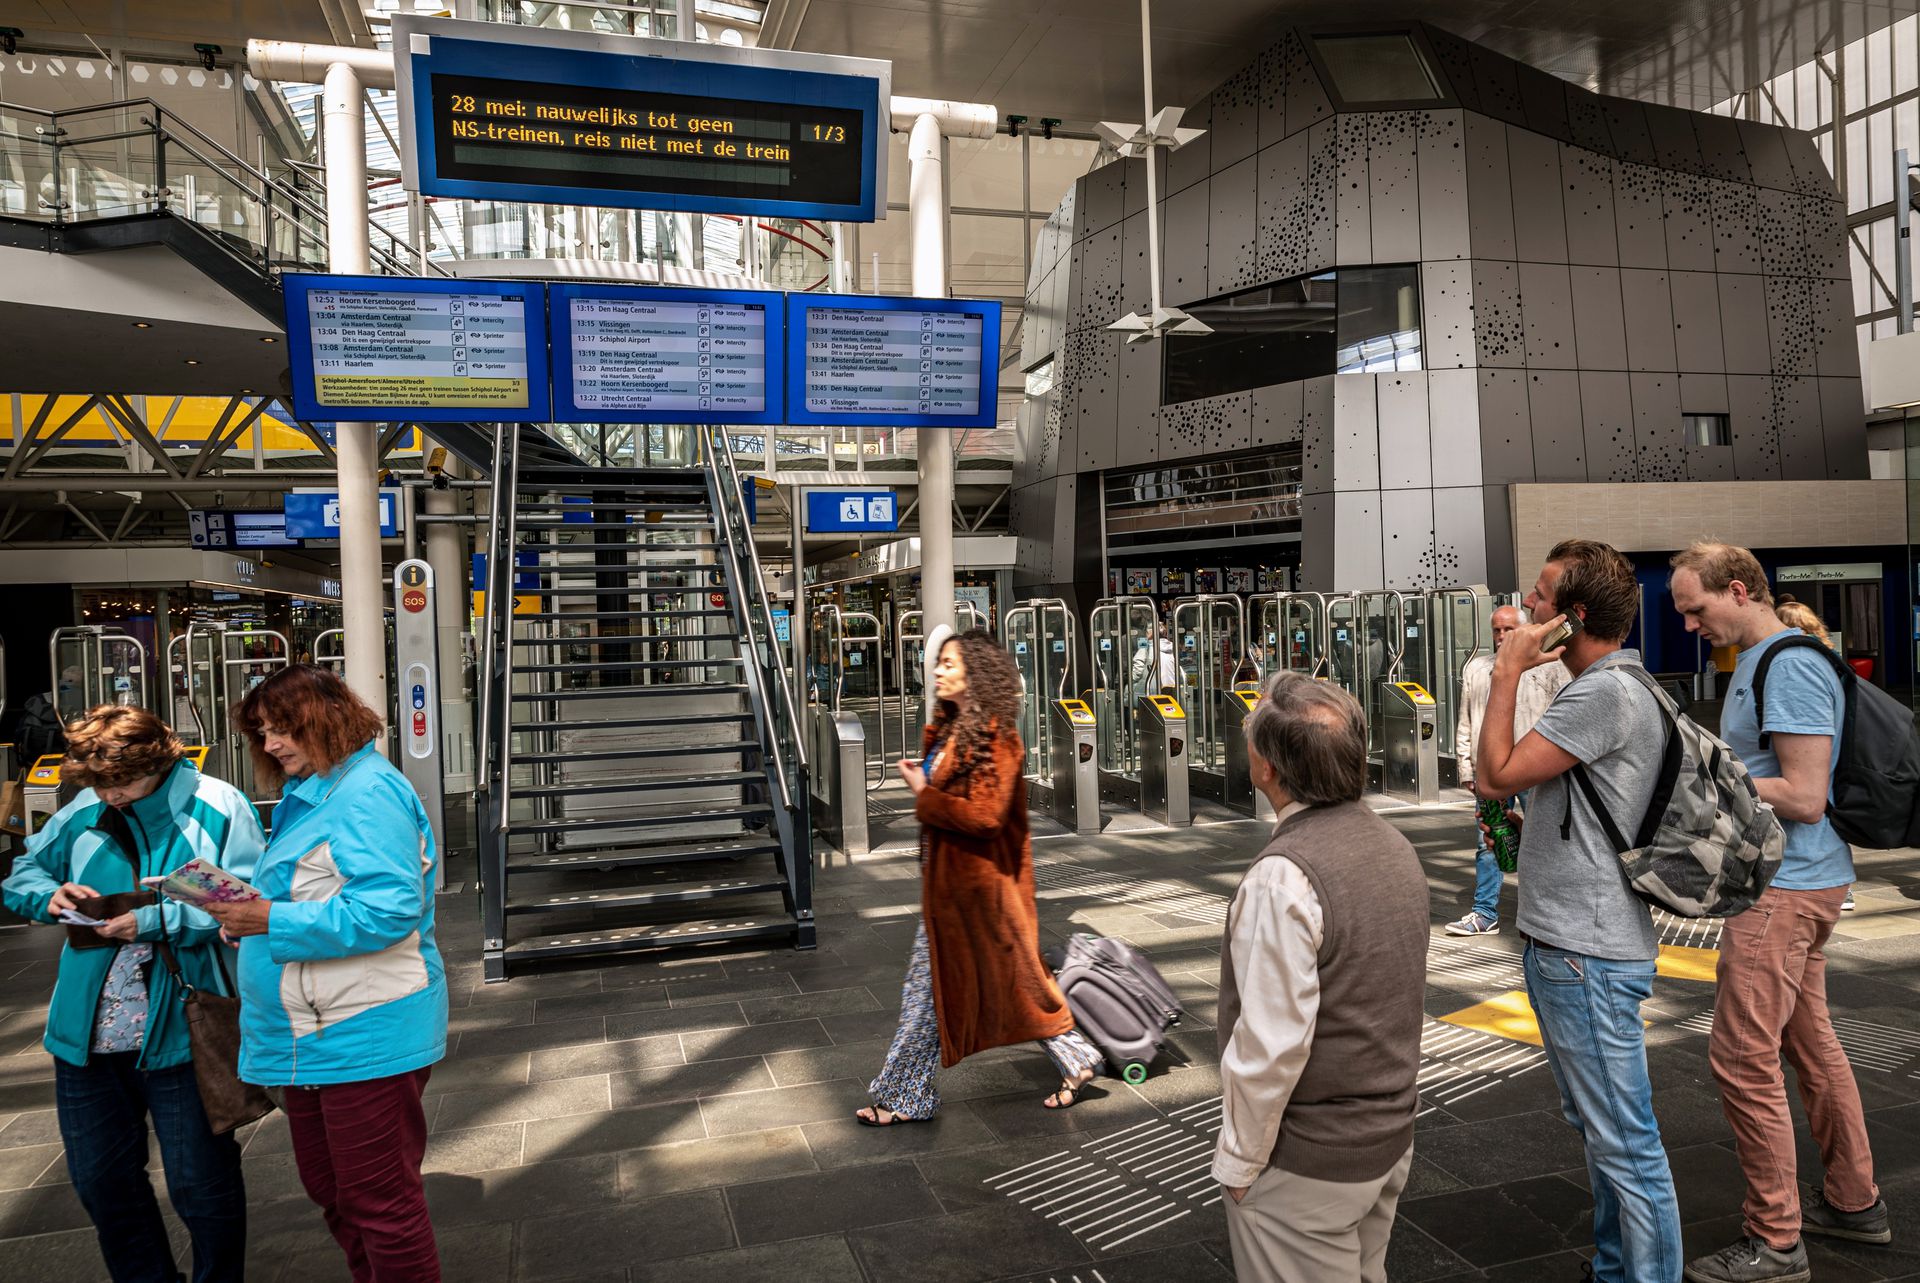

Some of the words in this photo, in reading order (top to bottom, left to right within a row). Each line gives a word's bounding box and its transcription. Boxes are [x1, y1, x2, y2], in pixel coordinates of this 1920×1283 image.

[451, 94, 475, 113] 28
[486, 98, 527, 117] mei:
[536, 102, 638, 127] nauwelijks
[648, 111, 678, 130] tot
[688, 116, 734, 135] geen
[812, 125, 847, 142] 1/3
[452, 120, 565, 146] NS-treinen,
[574, 130, 611, 148] reis
[621, 133, 657, 151] niet
[667, 138, 704, 155] met
[713, 140, 737, 158] de
[746, 143, 791, 161] trein
[363, 298, 416, 306] Kersenboogerd
[612, 306, 628, 314] Haag
[598, 321, 630, 329] Vlissingen
[358, 329, 376, 338] Haag
[628, 336, 650, 344] Airport
[622, 381, 668, 389] Kersenboogerd
[214, 520, 219, 528] 1
[216, 536, 222, 544] 2
[404, 597, 425, 606] SOS
